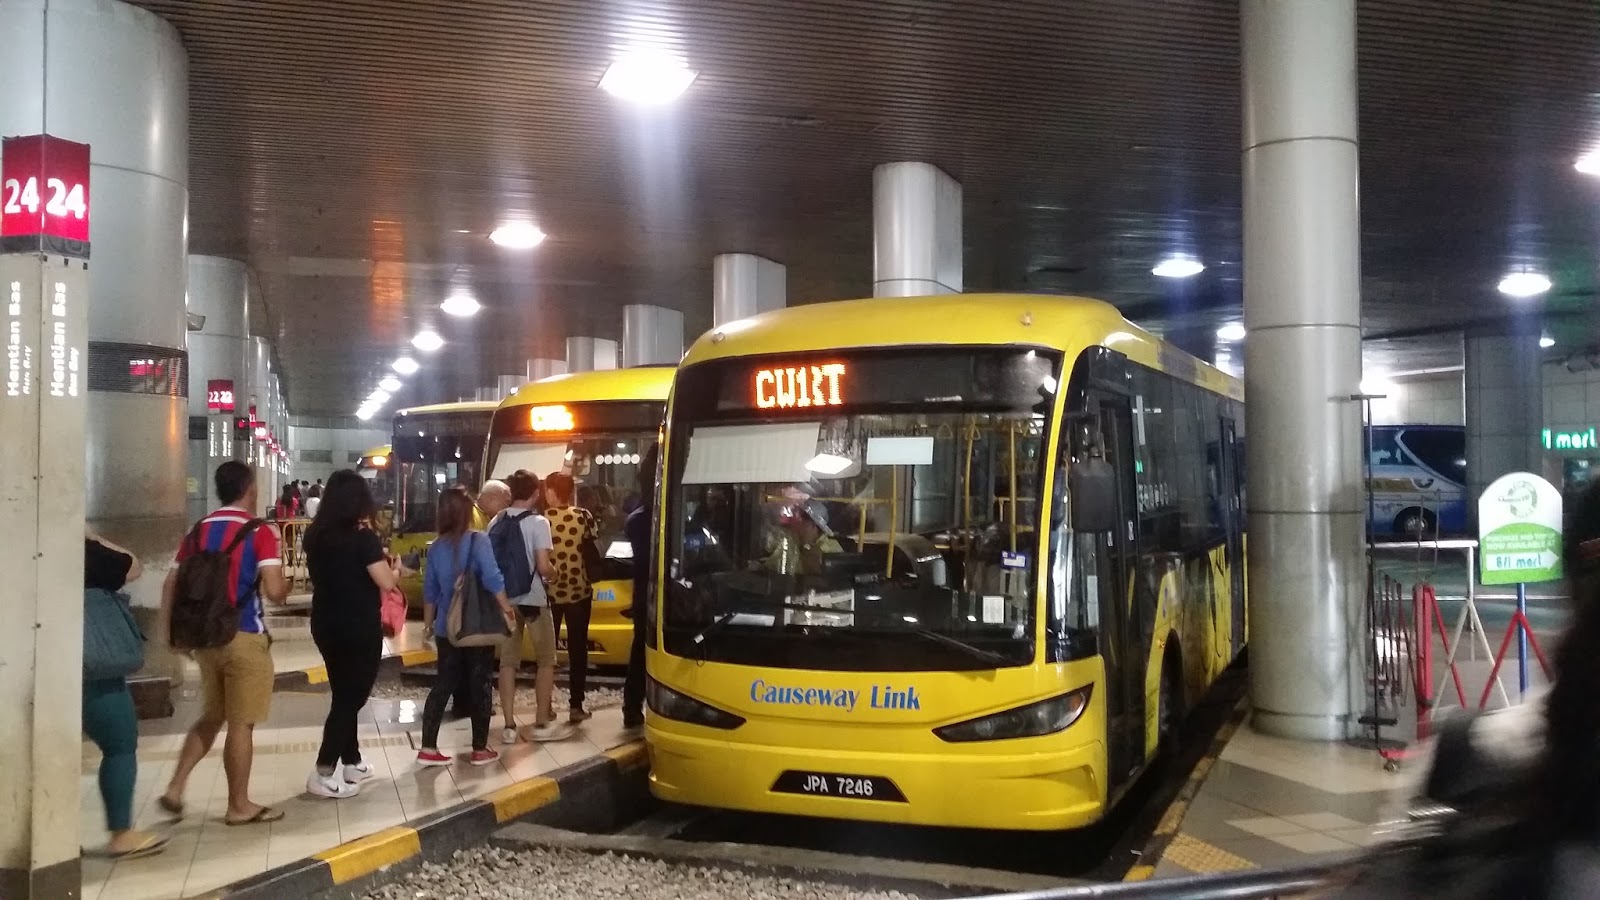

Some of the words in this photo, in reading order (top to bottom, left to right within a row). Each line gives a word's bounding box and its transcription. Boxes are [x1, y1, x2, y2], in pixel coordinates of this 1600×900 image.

[4, 176, 40, 214] 24
[46, 178, 87, 220] 24
[9, 281, 21, 316] Bas
[51, 282, 66, 317] Bas
[7, 321, 20, 396] Hentian
[50, 321, 66, 397] Hentian
[750, 679, 860, 713] Causeway
[870, 685, 921, 711] Link
[802, 774, 829, 793] JPA
[836, 777, 873, 796] 7246
